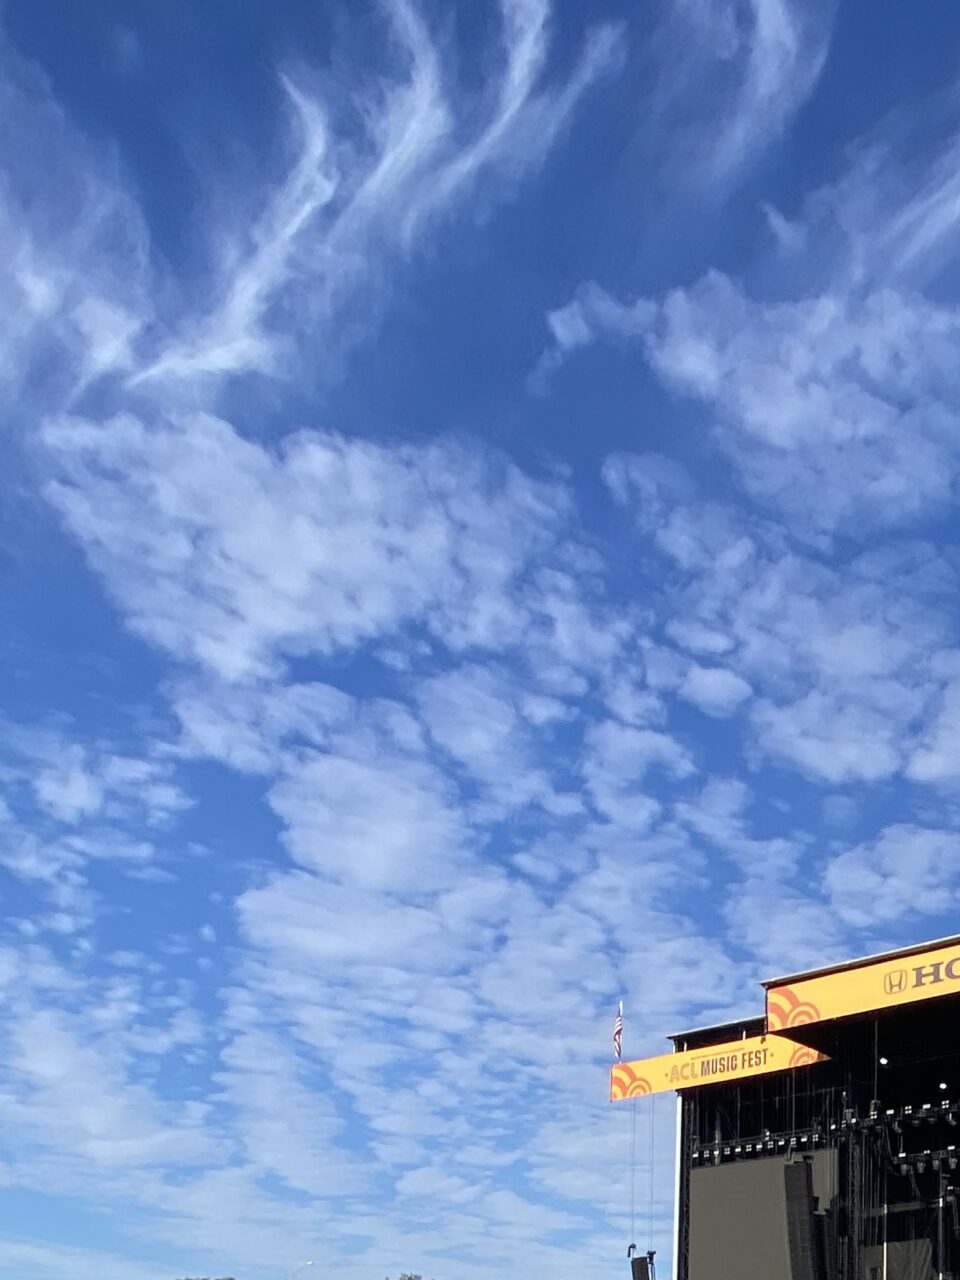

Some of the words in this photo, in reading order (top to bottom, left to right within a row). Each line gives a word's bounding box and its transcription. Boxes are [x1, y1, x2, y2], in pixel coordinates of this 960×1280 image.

[669, 1062, 699, 1083] ACL
[700, 1054, 738, 1077] MUSIC
[741, 1048, 769, 1070] FEST
